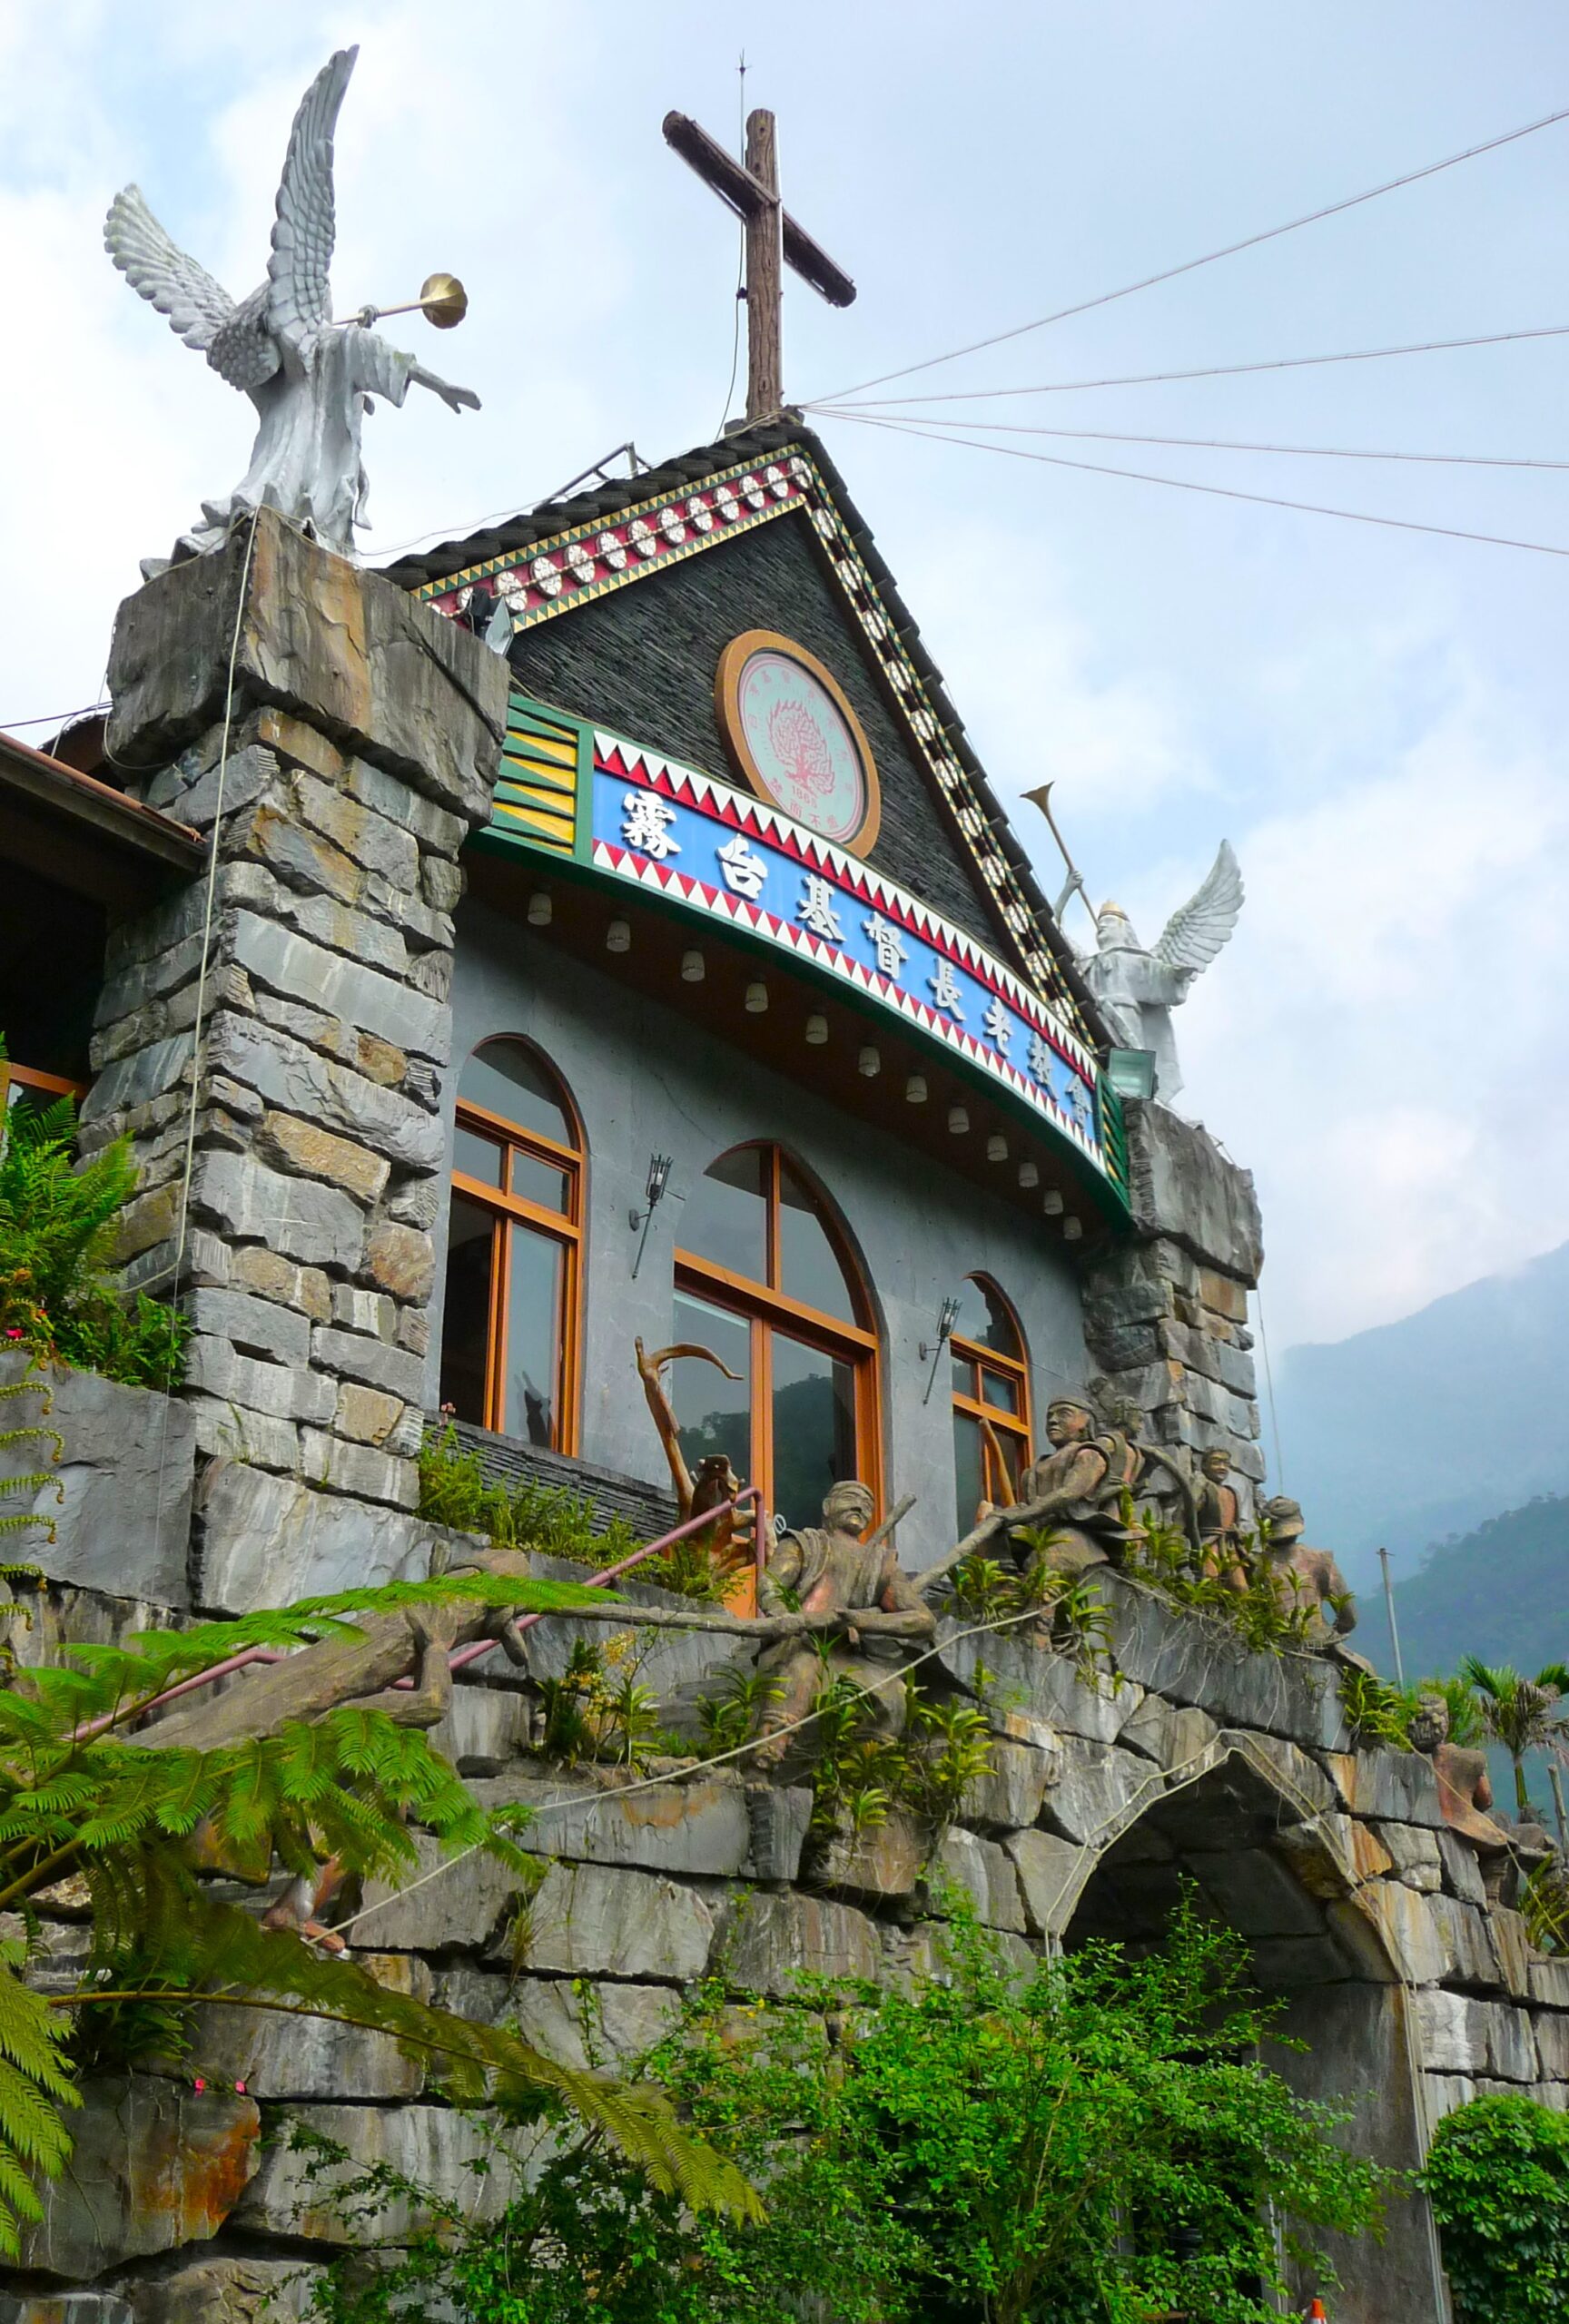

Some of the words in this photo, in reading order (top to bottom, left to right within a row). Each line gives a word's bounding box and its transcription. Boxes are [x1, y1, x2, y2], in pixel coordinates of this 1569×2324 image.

[621, 789, 1093, 1130] 霧台基督長老教會
